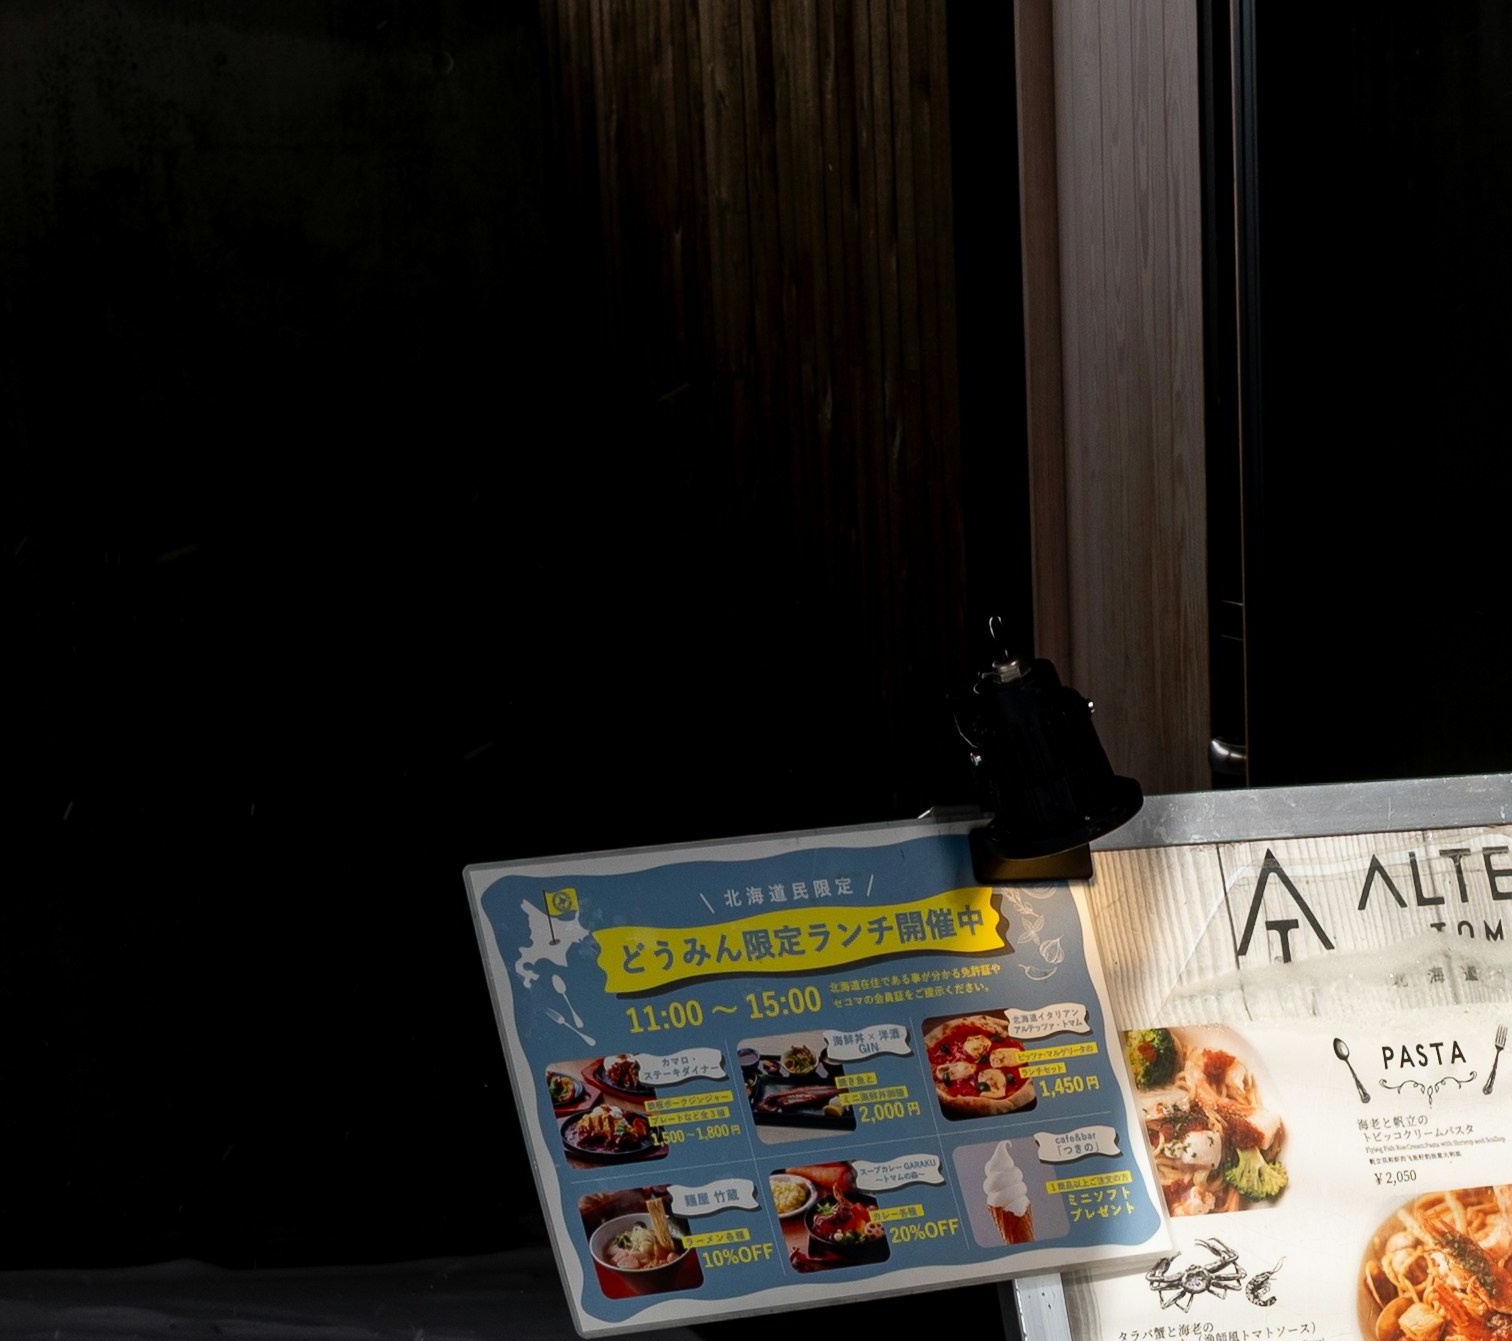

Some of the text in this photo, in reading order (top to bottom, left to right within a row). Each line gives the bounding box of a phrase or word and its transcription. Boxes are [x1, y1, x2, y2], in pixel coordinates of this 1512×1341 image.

[724, 876, 854, 908] 北海道民限定
[622, 904, 984, 974] どうみん限定ランチ開催中
[626, 986, 821, 1033] 11:00 15:00
[1013, 1009, 1078, 1024] 北海道イタリアン
[879, 1028, 900, 1041] 洋酒
[859, 1042, 879, 1054] GIN
[1382, 1040, 1467, 1070] PASTA
[644, 1064, 719, 1080] ステーキダイナー
[1357, 1115, 1428, 1131] 海老と帆立の
[1055, 1132, 1096, 1144] cafe&bar
[1364, 1124, 1474, 1143] トビッコクリームパスタ
[904, 1159, 936, 1170] GARAKU
[1375, 1169, 1417, 1186] ¥2,050
[1069, 1187, 1130, 1206] ミニソフト
[1071, 1201, 1134, 1222] プレゼント
[890, 1218, 959, 1244] 20%OFF
[702, 1243, 773, 1268] 10%OFF
